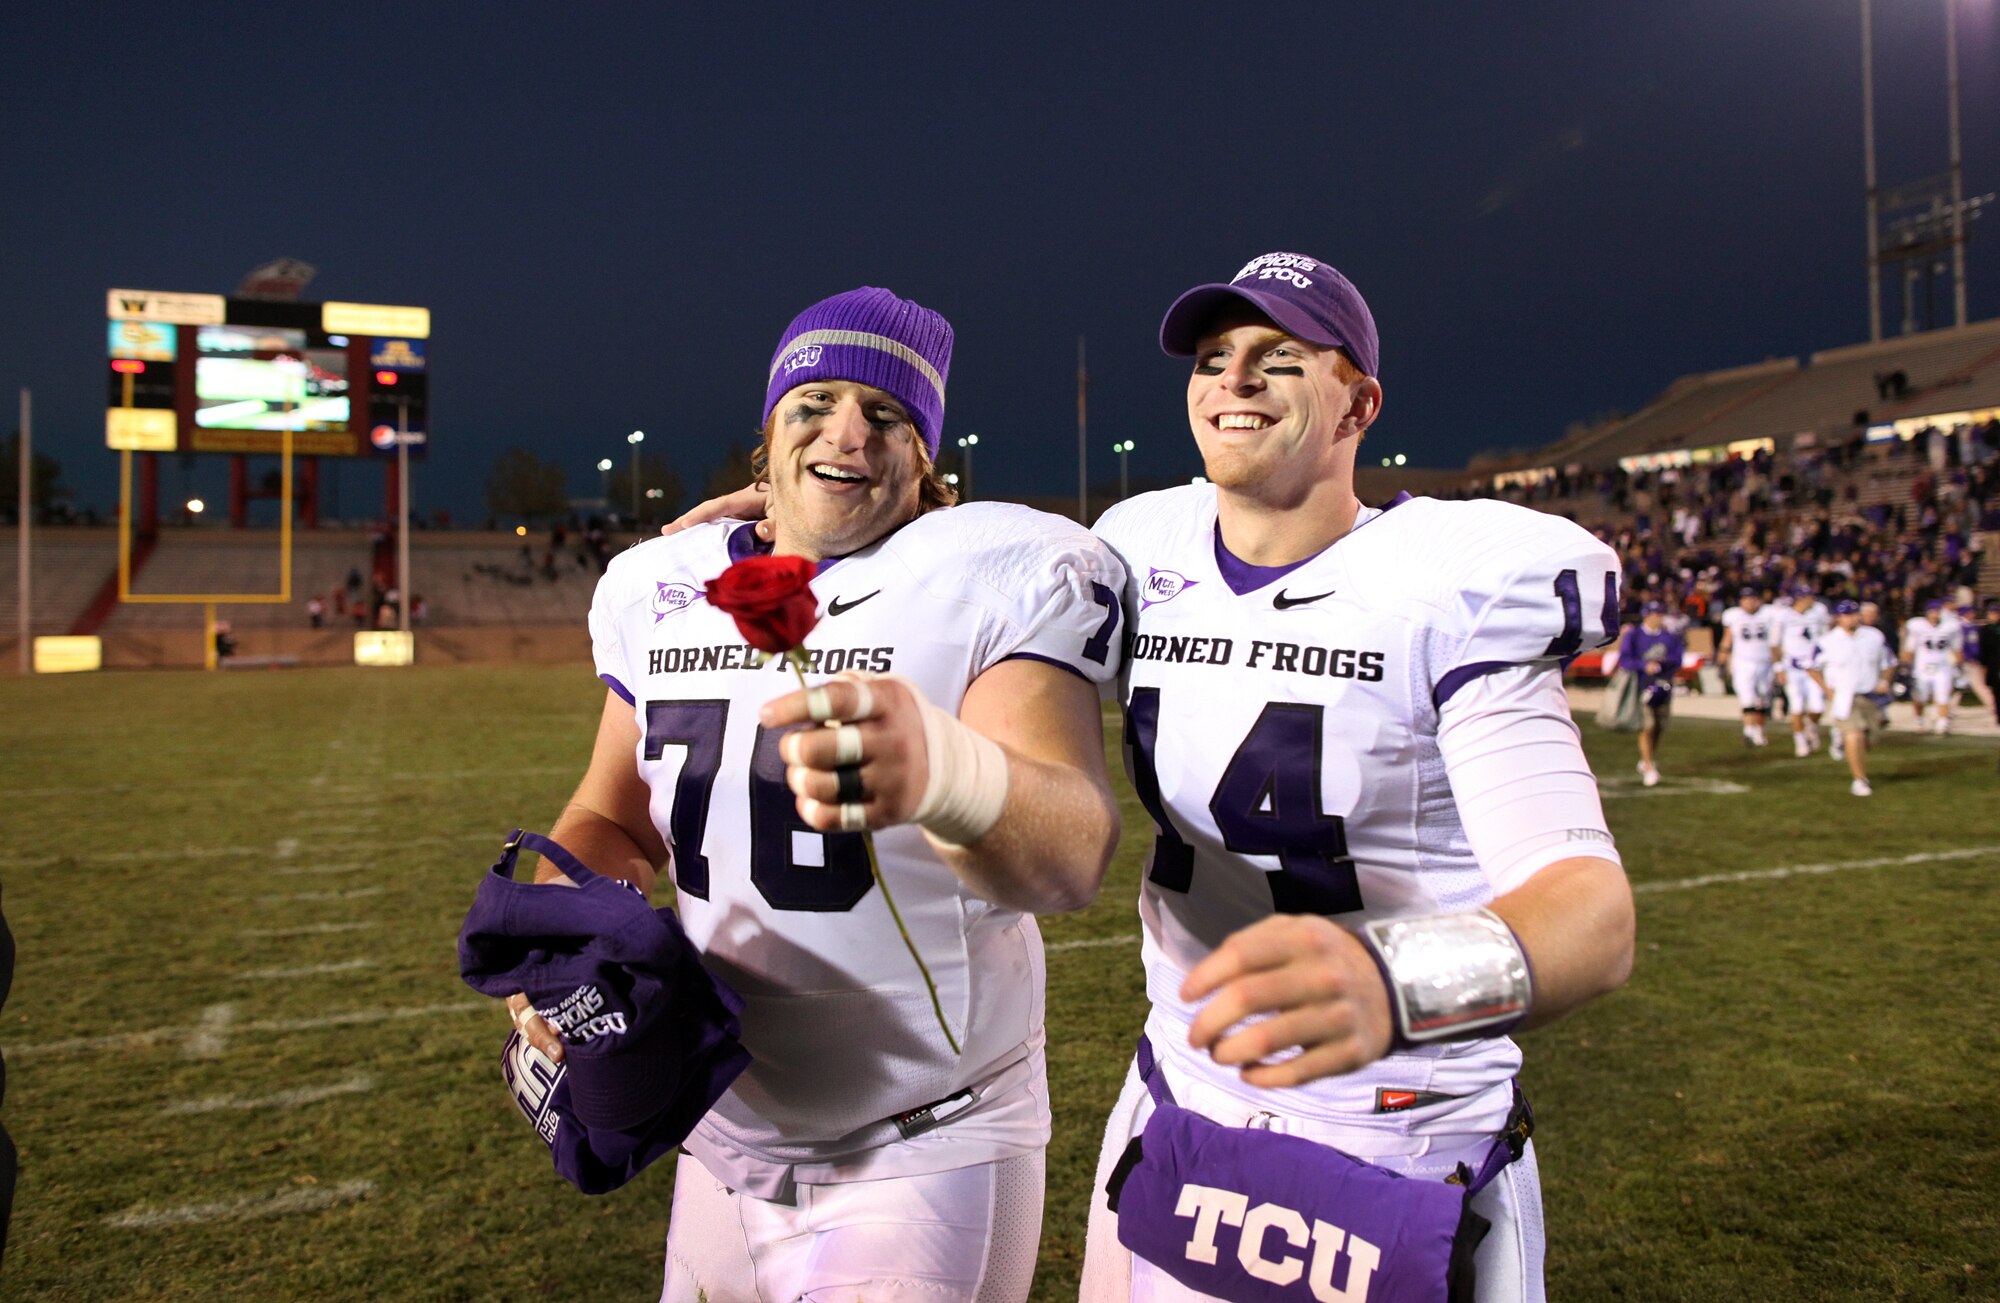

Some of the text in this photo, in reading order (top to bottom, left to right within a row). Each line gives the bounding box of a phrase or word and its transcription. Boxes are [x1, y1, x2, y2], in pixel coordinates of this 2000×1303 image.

[1258, 267, 1313, 289] TCU
[784, 345, 822, 376] TCU
[659, 589, 687, 602] Mtn.
[1246, 641, 1384, 682] FROGS
[1126, 687, 1364, 915] 14
[572, 1012, 627, 1042] TCU
[1174, 1183, 1381, 1302] TCU
